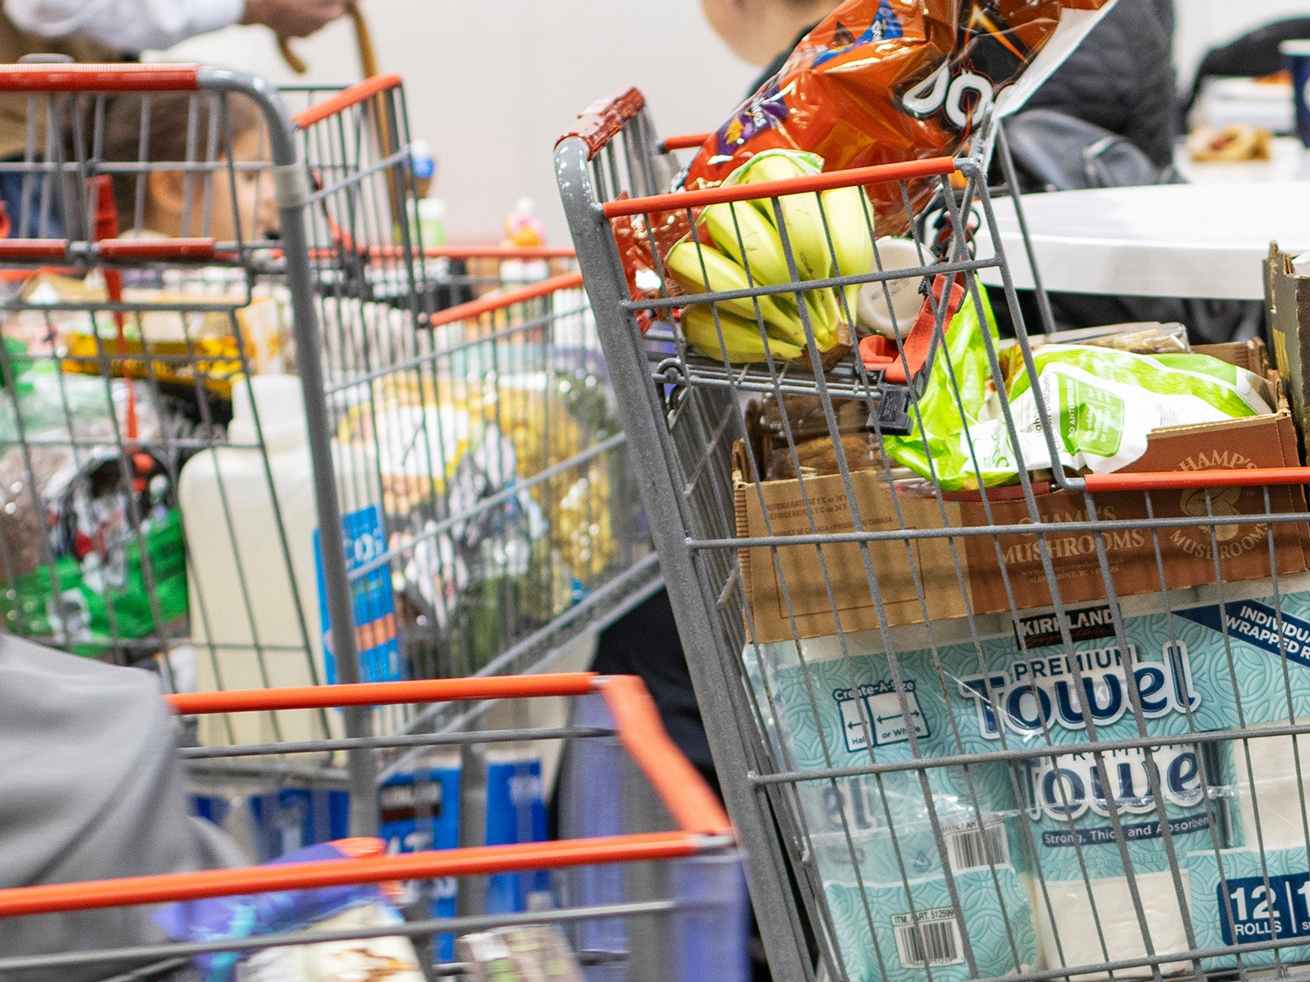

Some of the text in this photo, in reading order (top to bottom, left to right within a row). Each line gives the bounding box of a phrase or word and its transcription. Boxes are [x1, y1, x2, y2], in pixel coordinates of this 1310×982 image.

[1225, 615, 1299, 653] WRAPPED
[963, 645, 1197, 738] Towel
[1089, 830, 1116, 841] Thic
[1127, 825, 1151, 836] and
[1230, 885, 1280, 920] 12
[1235, 921, 1282, 936] ROLLS
